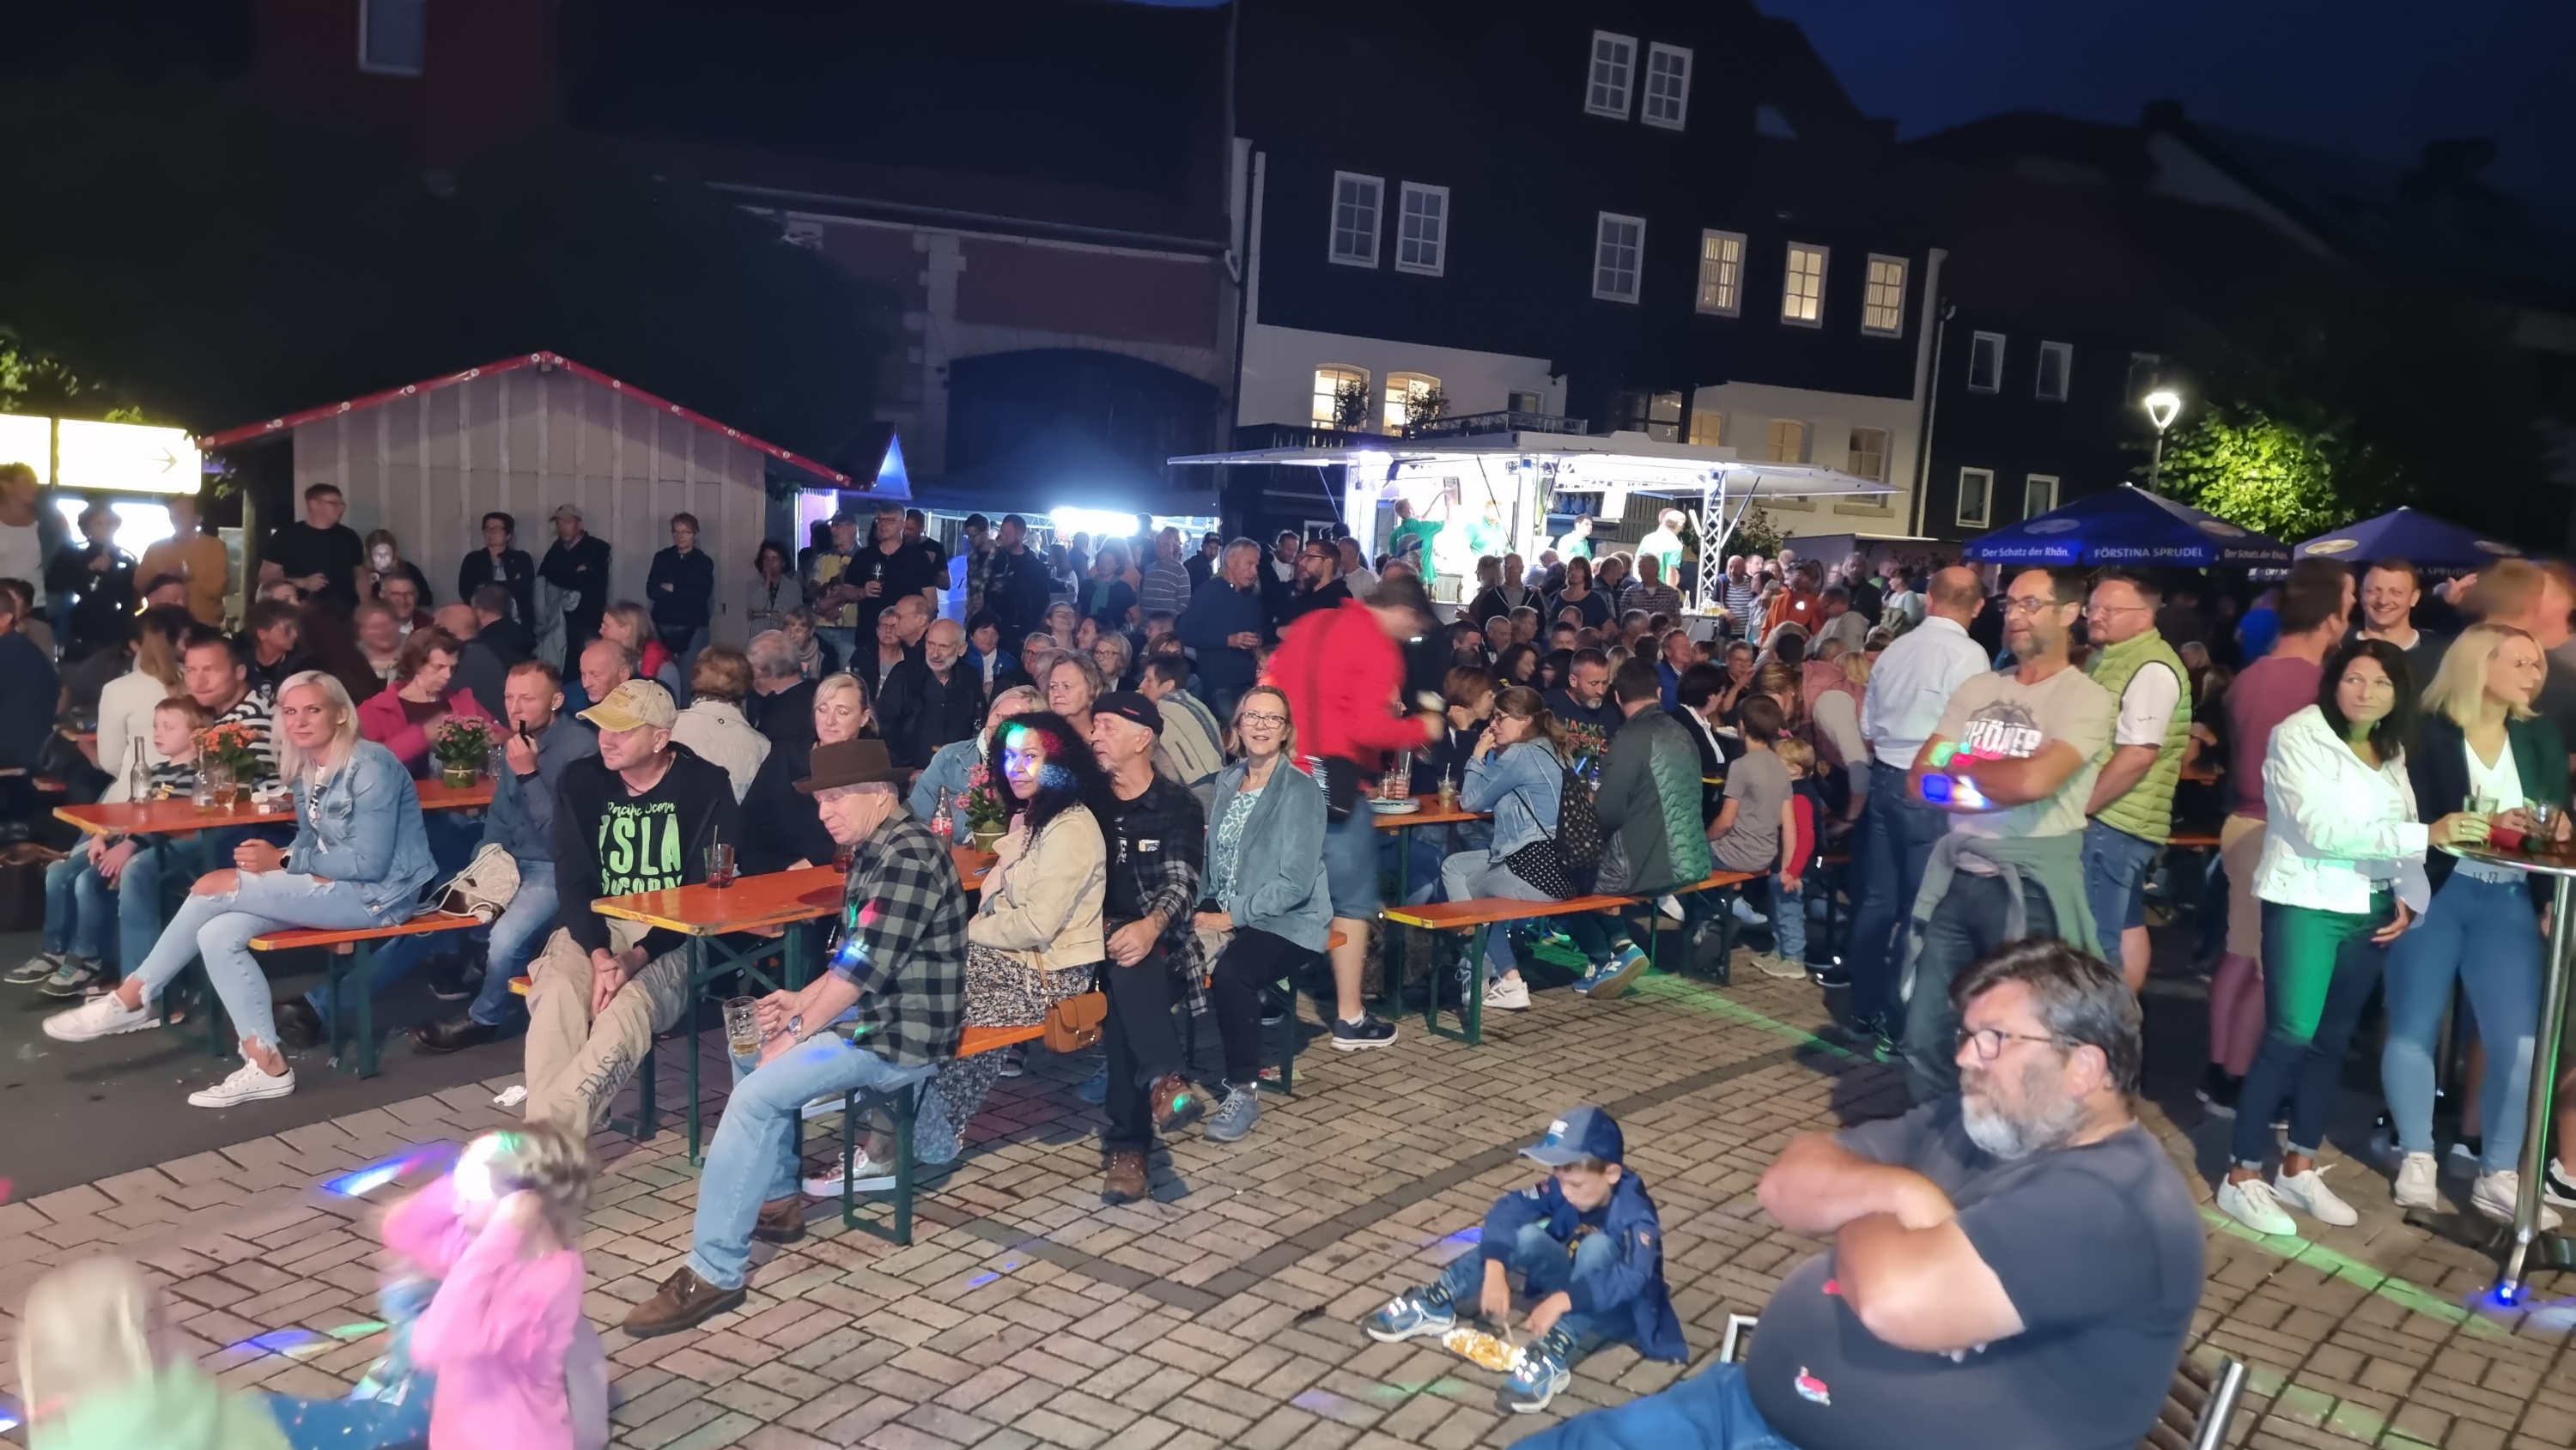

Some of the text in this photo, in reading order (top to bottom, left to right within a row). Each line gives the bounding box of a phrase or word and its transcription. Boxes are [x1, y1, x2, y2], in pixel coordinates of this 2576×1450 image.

[1982, 547, 2070, 557] Der Schatz der Rhön.
[2094, 546, 2204, 558] FÖRSTINA SPRUDEL
